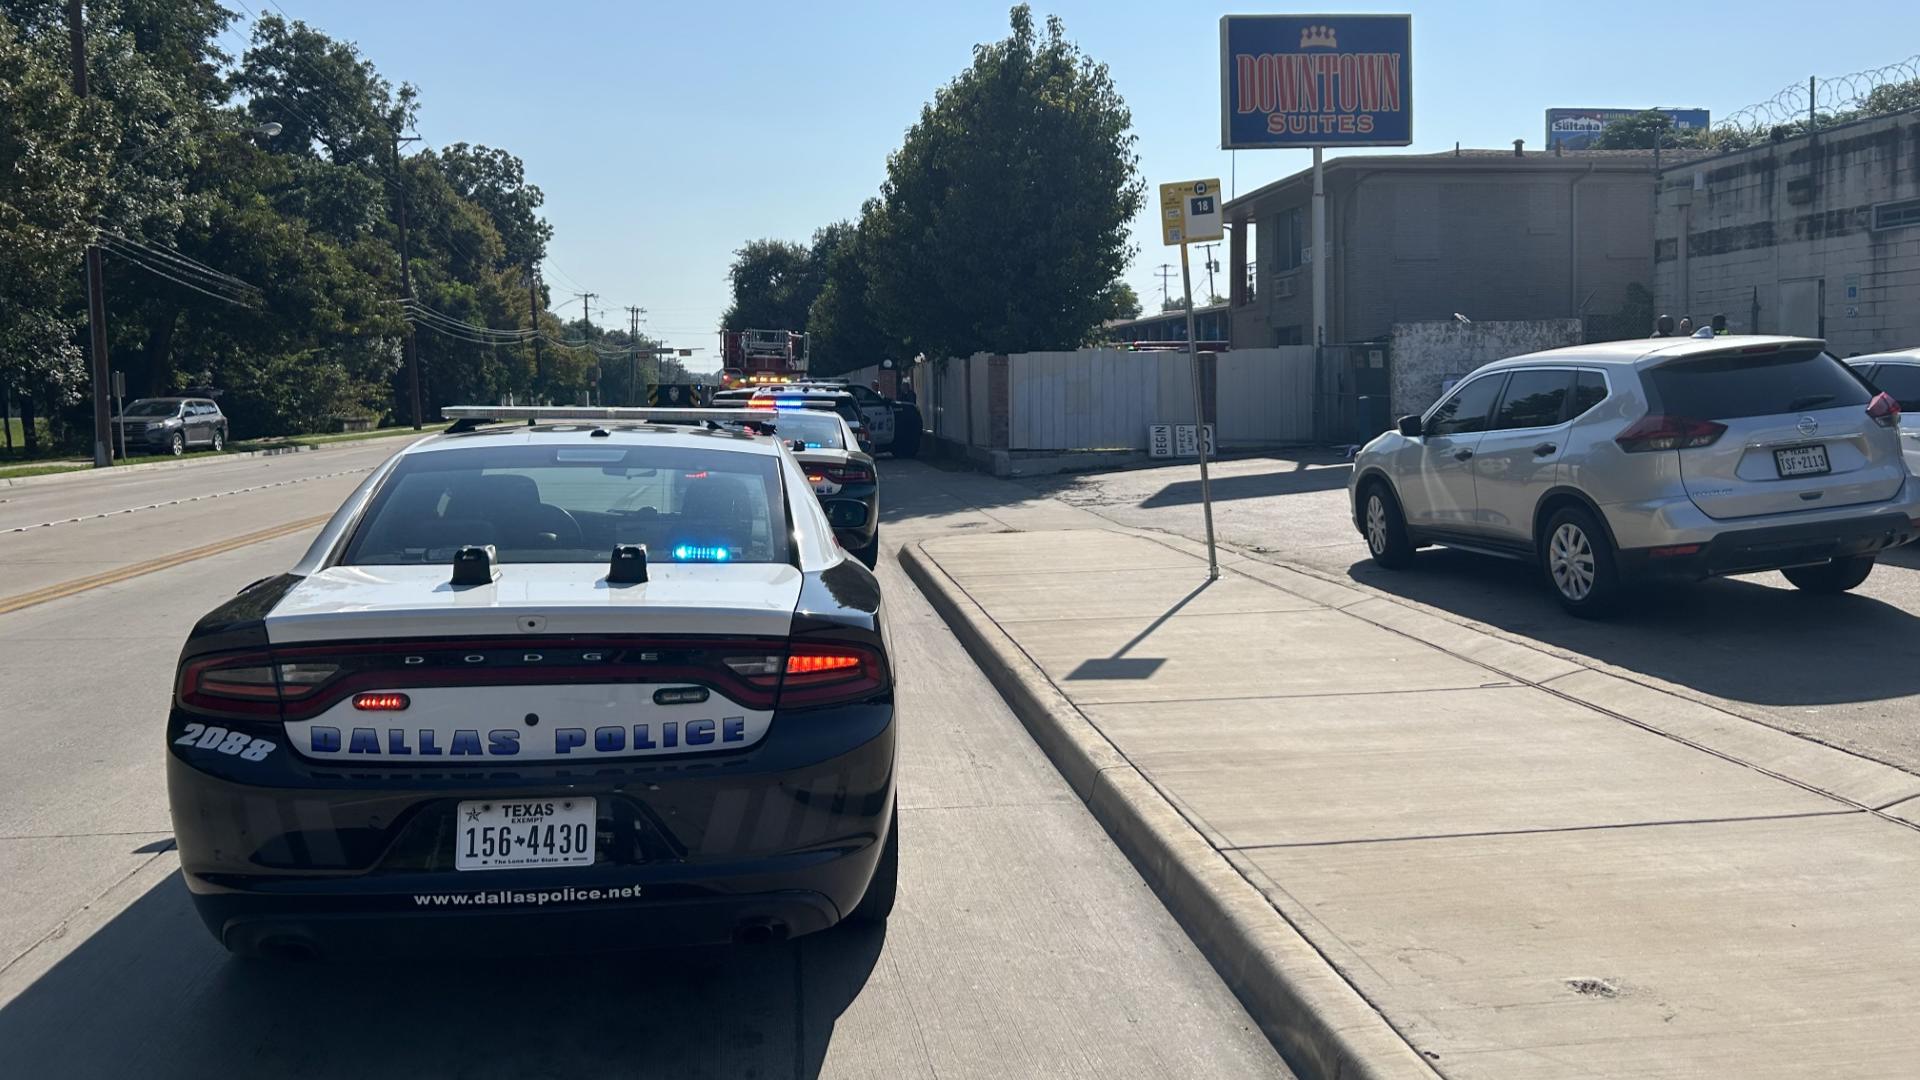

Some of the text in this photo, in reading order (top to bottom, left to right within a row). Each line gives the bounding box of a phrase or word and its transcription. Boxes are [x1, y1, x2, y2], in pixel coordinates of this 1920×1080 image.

[1236, 53, 1400, 114] DOWNTOWN
[1196, 200, 1209, 212] 18
[1155, 426, 1168, 455] BEGIN
[1178, 426, 1186, 454] SPEED
[404, 652, 659, 665] DODGE
[310, 715, 746, 756] DALLAS POLICE
[502, 803, 555, 818] TEXAS
[511, 816, 544, 825] EXEMPT
[413, 883, 643, 906] www.dallaspolice.net
